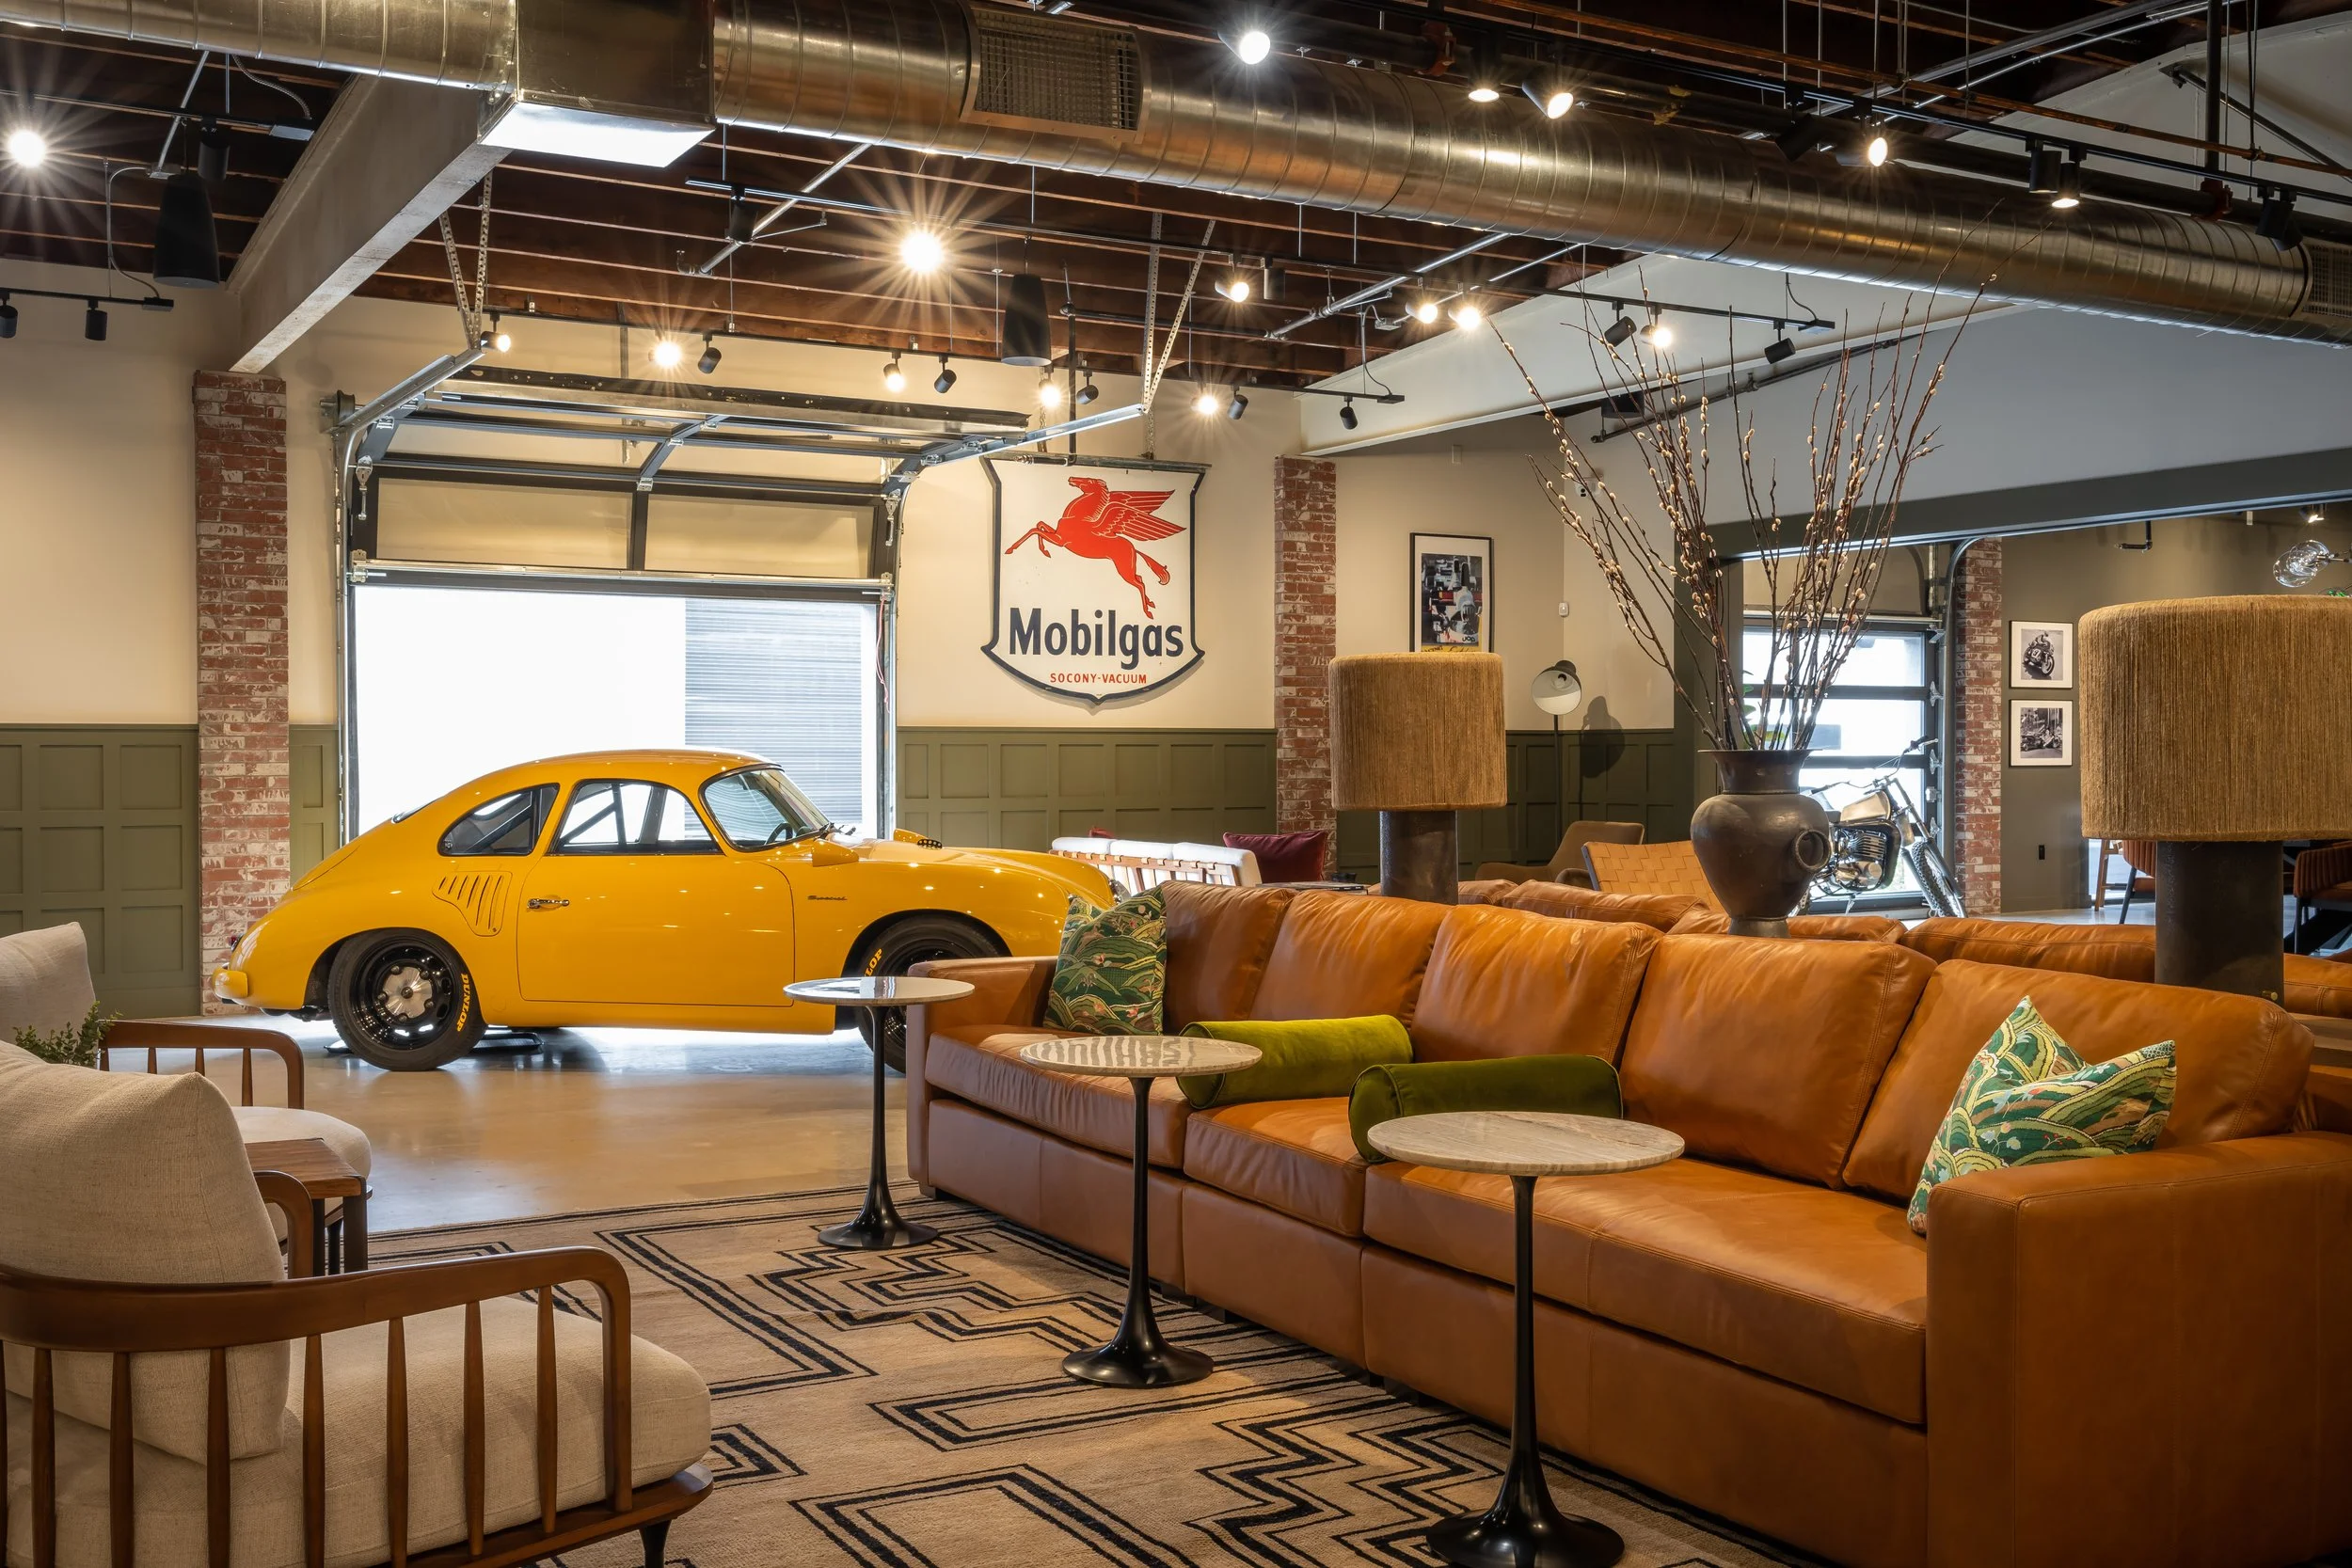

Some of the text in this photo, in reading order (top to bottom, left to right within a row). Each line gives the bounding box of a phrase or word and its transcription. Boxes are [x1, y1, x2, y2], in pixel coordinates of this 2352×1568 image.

[1009, 607, 1184, 670] Mobilgas
[1050, 673, 1147, 684] SOCONY-VACUUM
[864, 948, 882, 976] LOP
[456, 973, 470, 1032] DUNLOP
